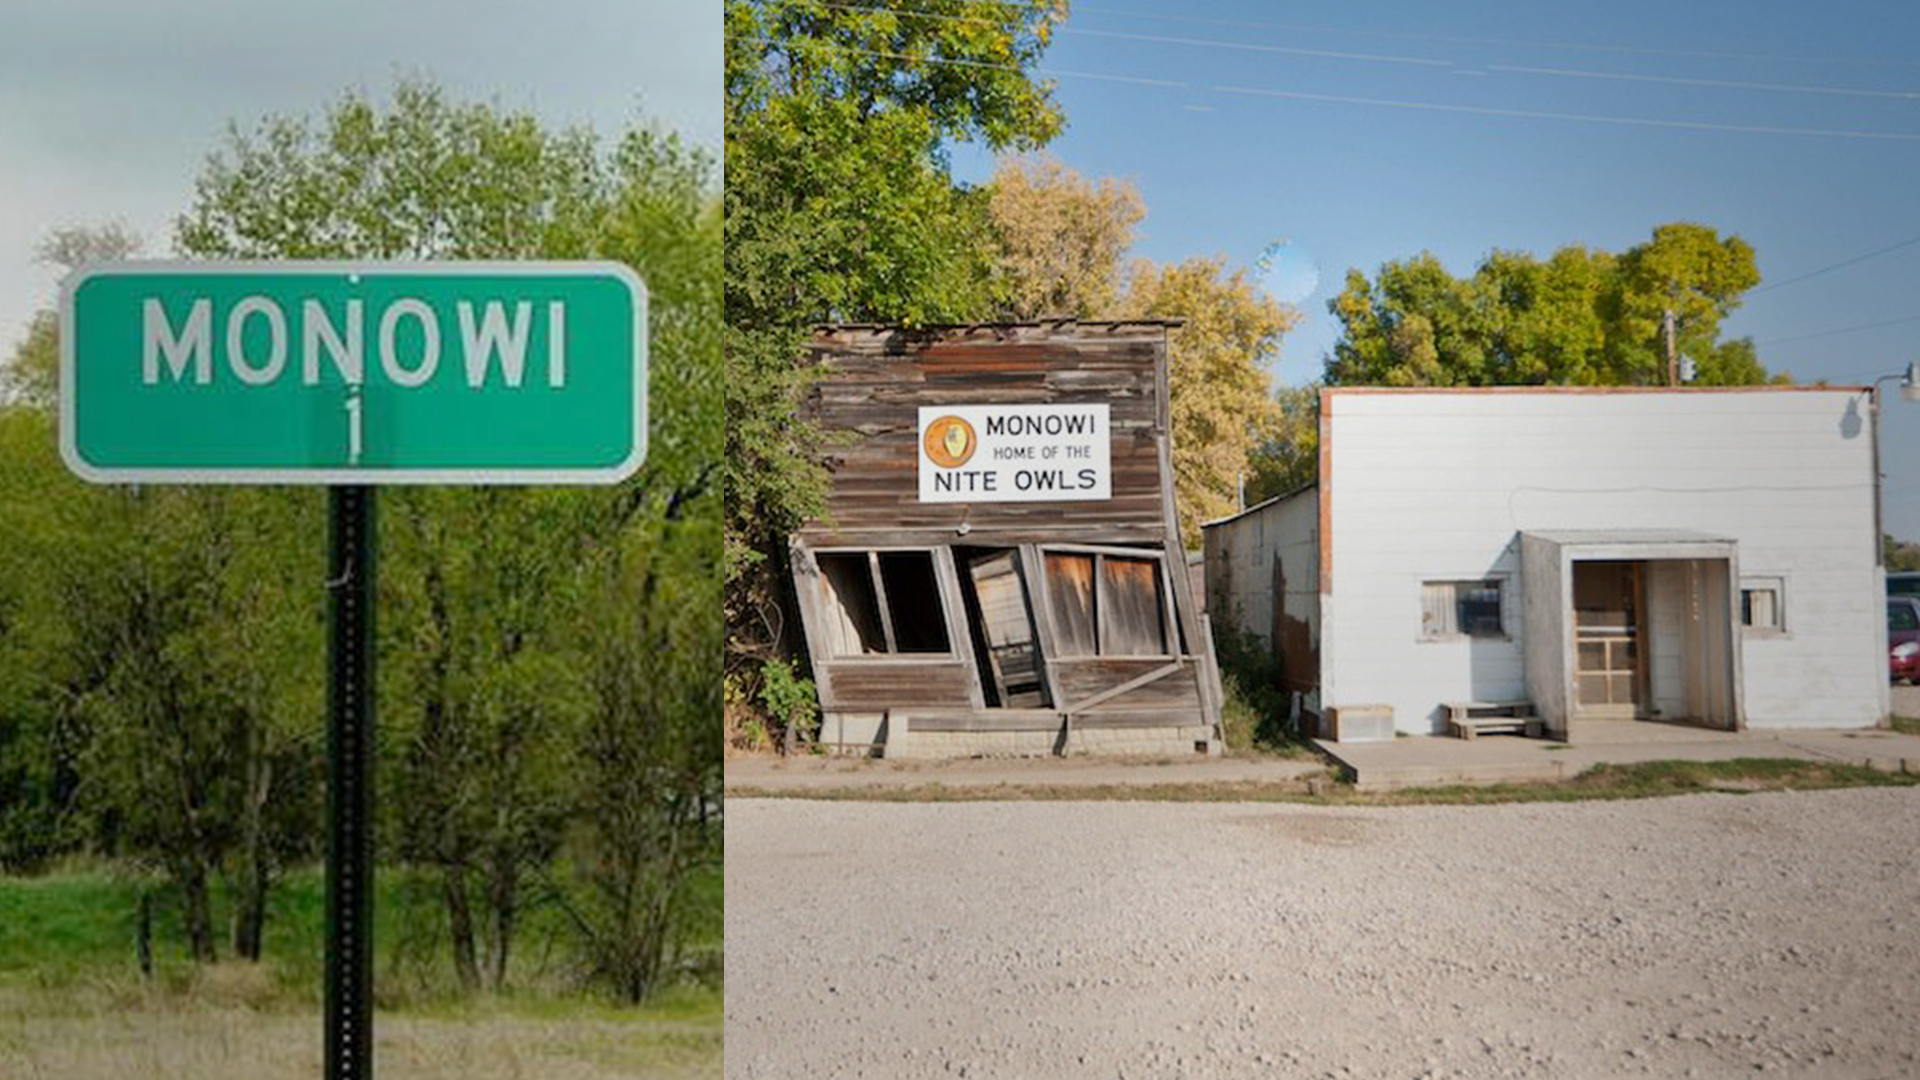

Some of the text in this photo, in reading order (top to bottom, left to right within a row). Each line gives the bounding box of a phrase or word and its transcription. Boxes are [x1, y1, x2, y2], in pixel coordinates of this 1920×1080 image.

[142, 296, 566, 388] MONOWI
[345, 397, 362, 465] 1
[986, 414, 1096, 436] MONOWI
[993, 445, 1091, 460] HOME OF THE
[935, 469, 1097, 492] NITE OWLS
